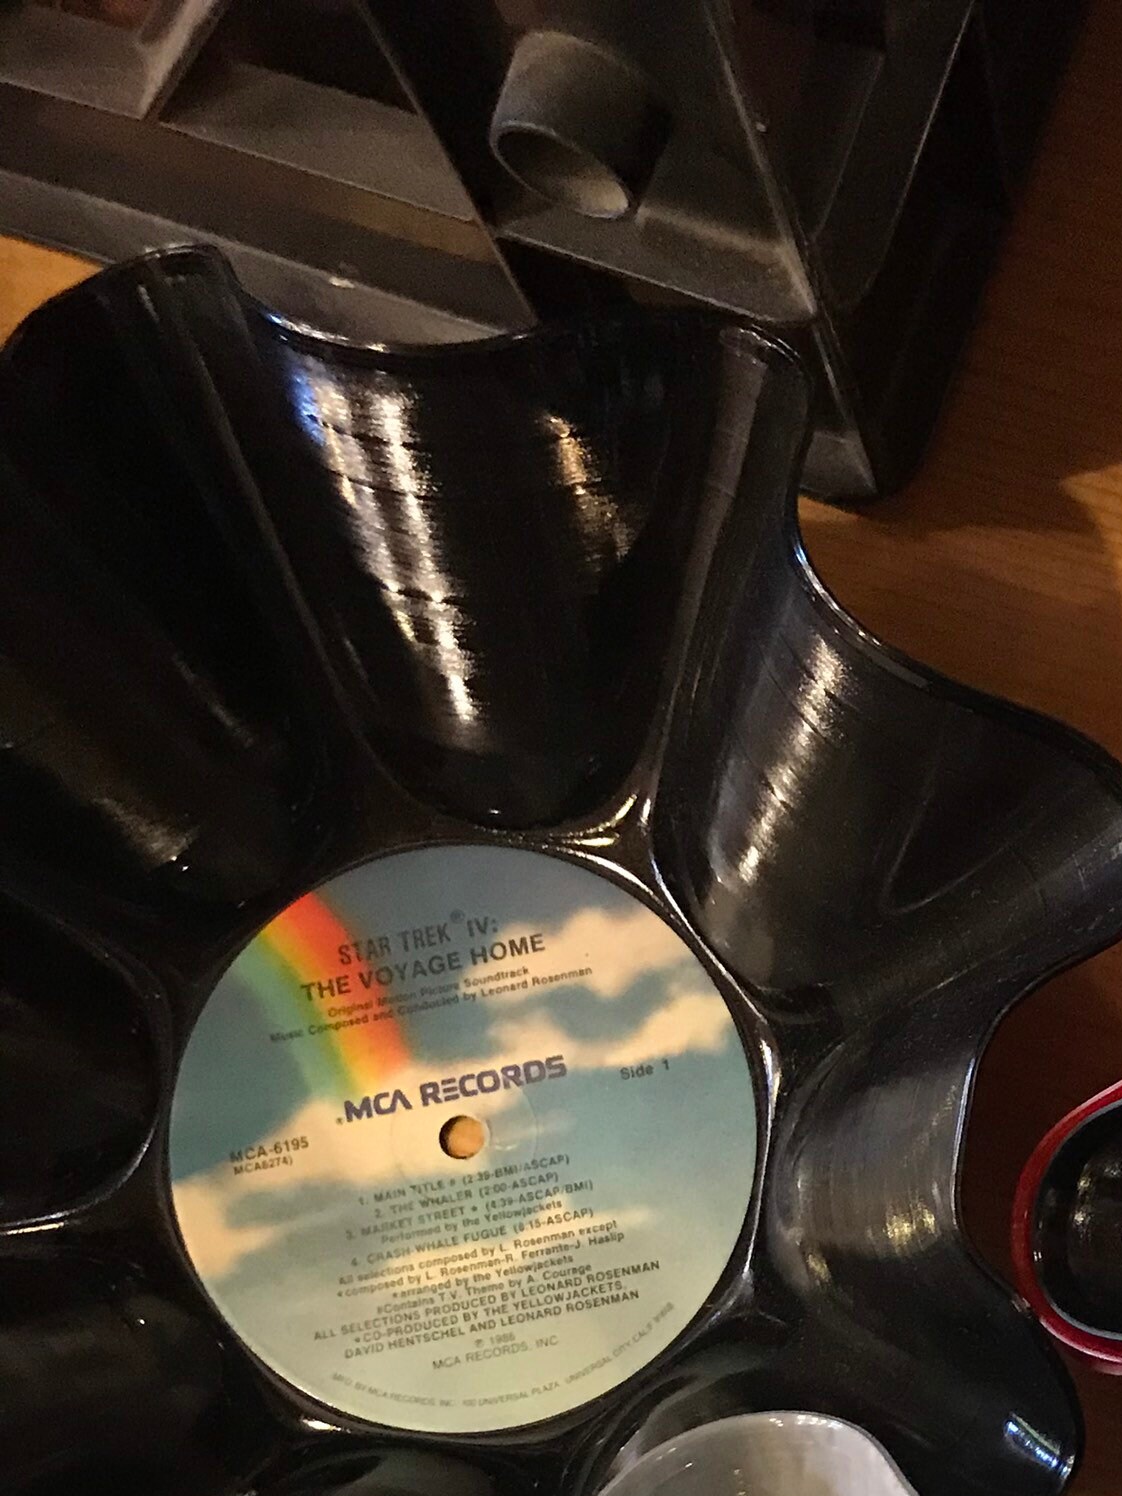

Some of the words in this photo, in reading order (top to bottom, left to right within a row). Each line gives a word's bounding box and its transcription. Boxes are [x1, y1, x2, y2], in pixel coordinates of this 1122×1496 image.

[338, 936, 391, 965] STAR
[467, 916, 498, 937] IV:
[300, 975, 351, 1001] THE
[358, 951, 463, 990] VOYAGE
[470, 933, 546, 966] HOME
[328, 1000, 373, 1018] Original
[464, 966, 529, 987] Soundtrack
[308, 1016, 369, 1036] Composed
[373, 1009, 394, 1021] and
[397, 995, 459, 1016] Conducted
[463, 990, 477, 1003] by
[481, 980, 529, 998] Leonard
[532, 967, 593, 987] Rosenman
[344, 1089, 413, 1123] MCA
[419, 1055, 567, 1106] RECORDS
[619, 1063, 655, 1081] Side
[662, 1059, 671, 1071] 1
[229, 1136, 310, 1164] MCA-6195
[374, 1188, 406, 1202] MAIN
[419, 1189, 473, 1208] WHALER
[314, 1328, 336, 1341] ALL
[341, 1310, 421, 1335] SELECTIONS
[425, 1295, 497, 1317] PRODUCED
[501, 1288, 517, 1301] BY
[521, 1278, 583, 1298] LEONARD
[587, 1260, 660, 1284] ROSENMAN
[344, 1343, 385, 1359] DAVID
[388, 1329, 466, 1351] HENTSCHEL
[470, 1318, 497, 1333] AND
[501, 1305, 562, 1327] LEONARD
[566, 1290, 640, 1312] ROSENMAN
